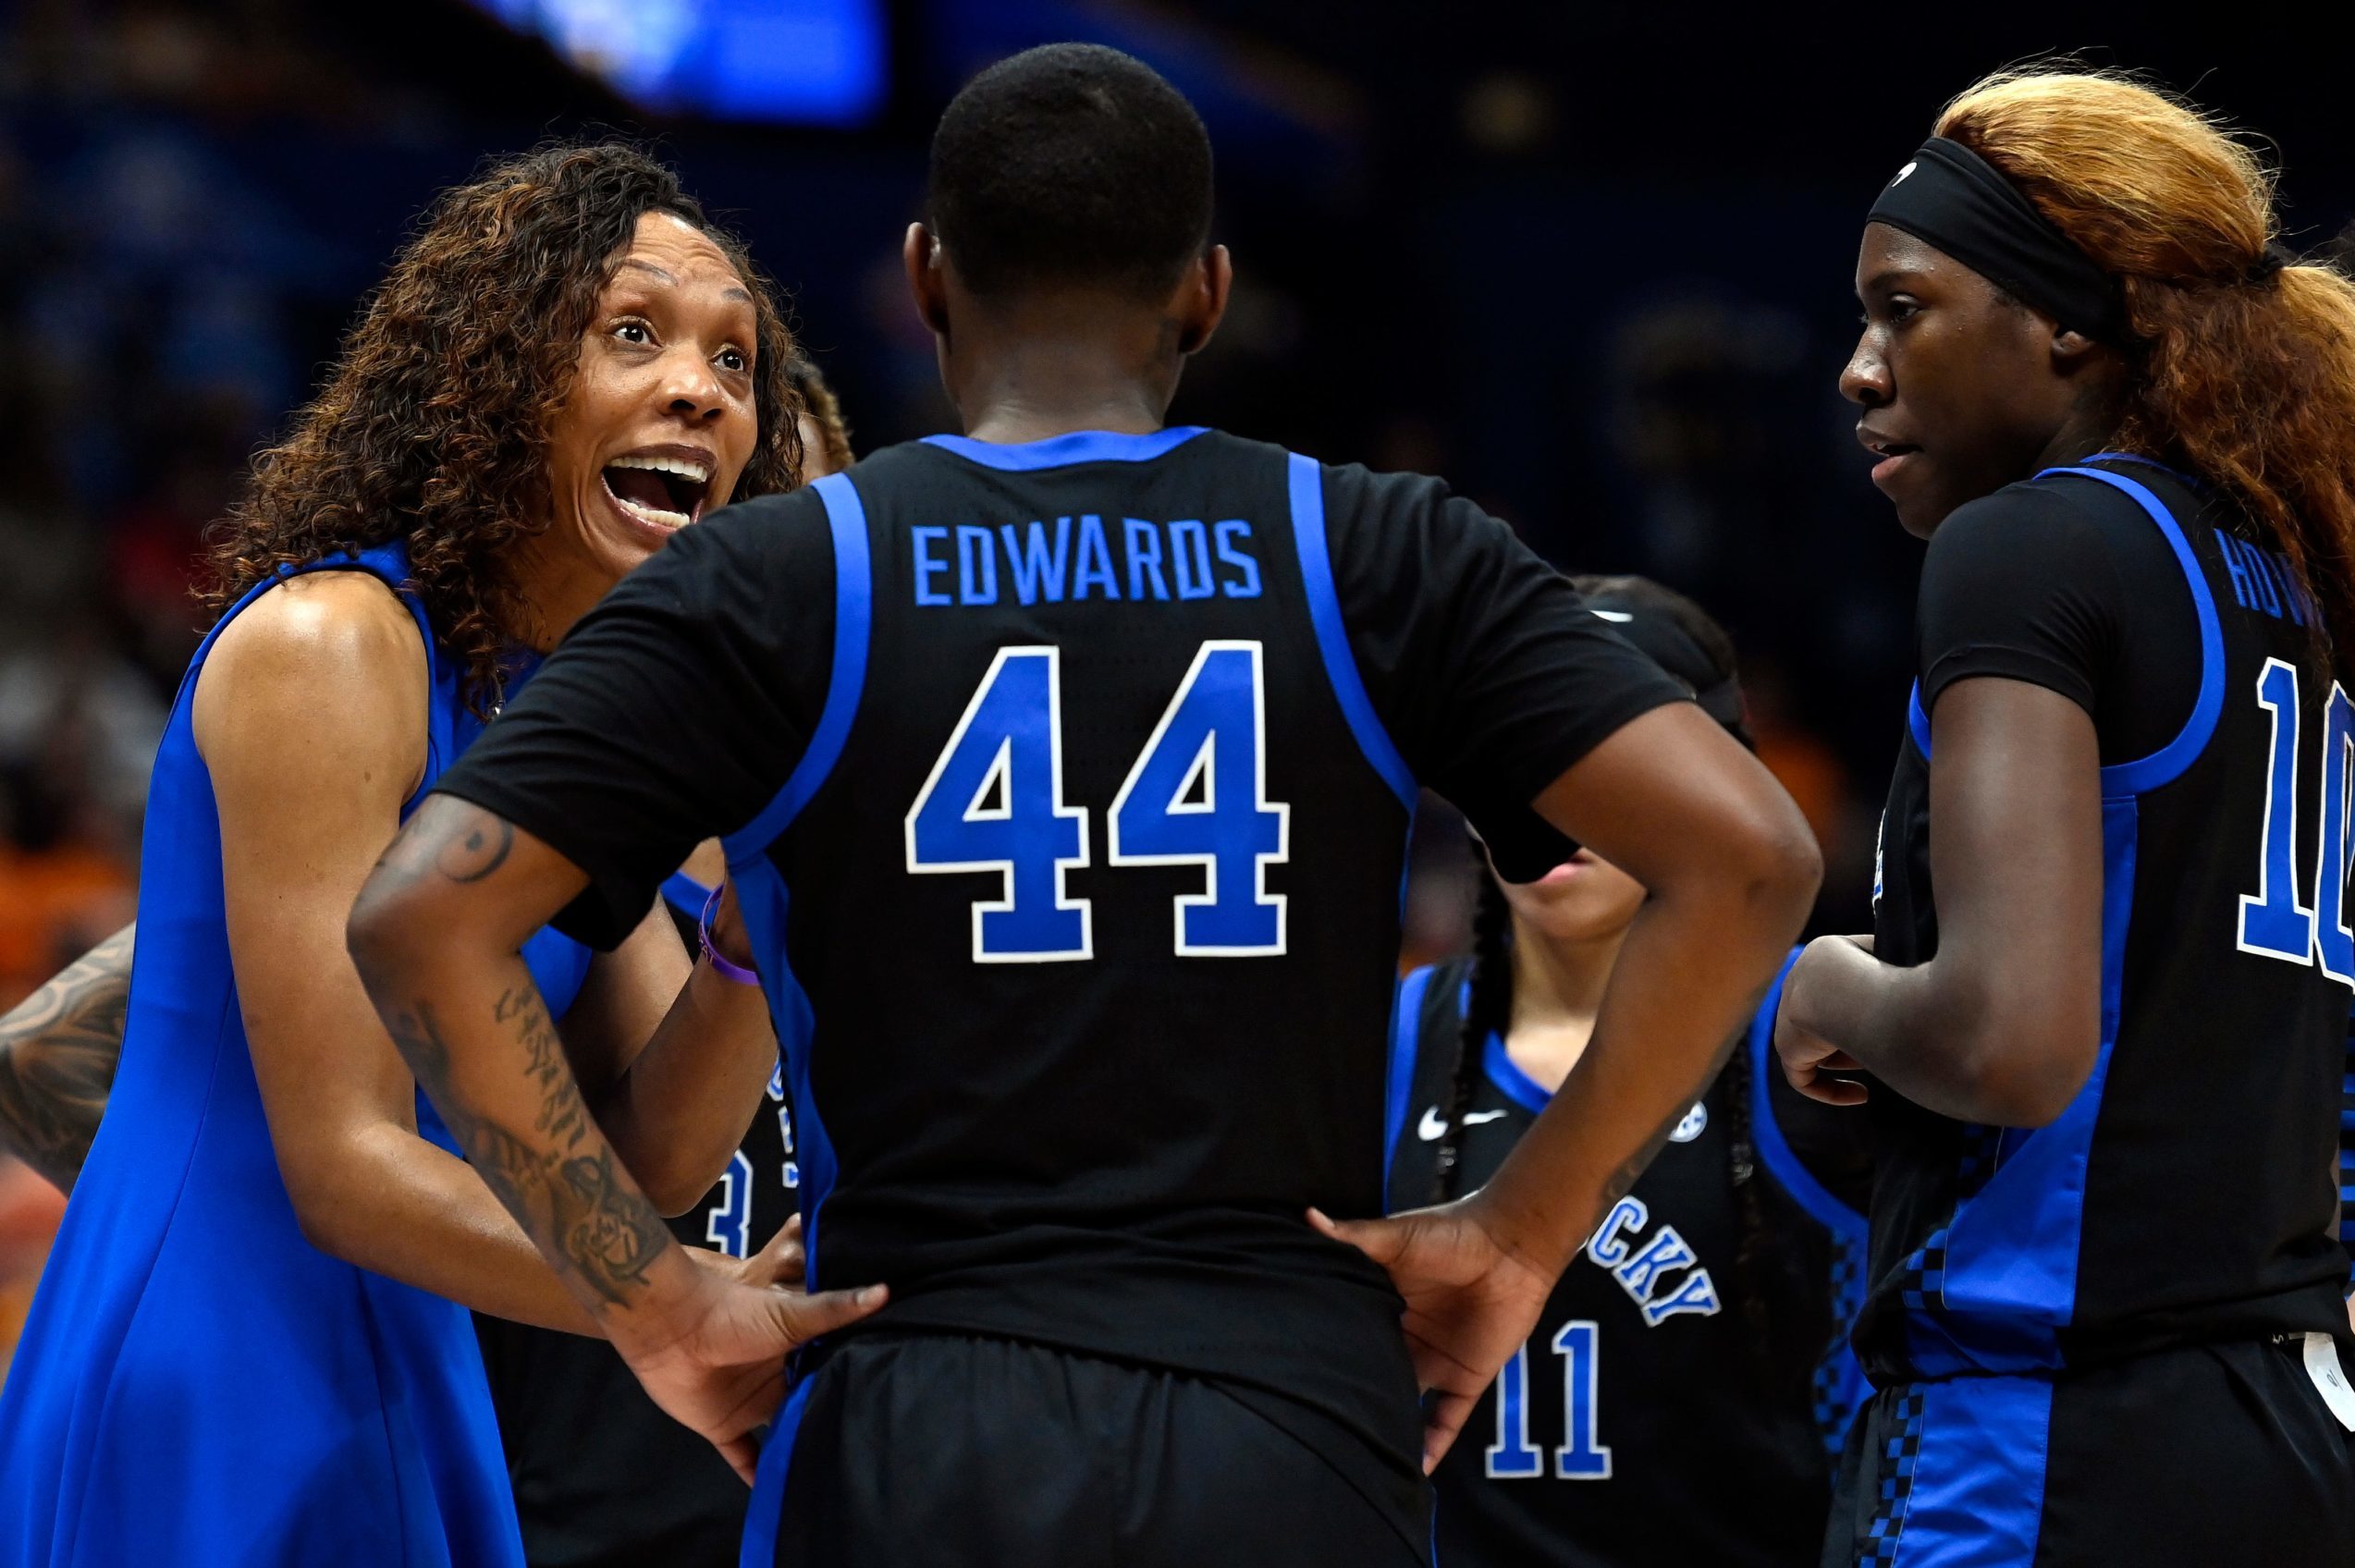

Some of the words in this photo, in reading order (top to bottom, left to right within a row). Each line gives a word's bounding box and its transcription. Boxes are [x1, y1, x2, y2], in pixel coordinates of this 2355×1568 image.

[911, 514, 1263, 607] EDWARDS
[904, 640, 1291, 963] 44
[1576, 1194, 1723, 1328] CKY
[1485, 1319, 1613, 1479] 11
